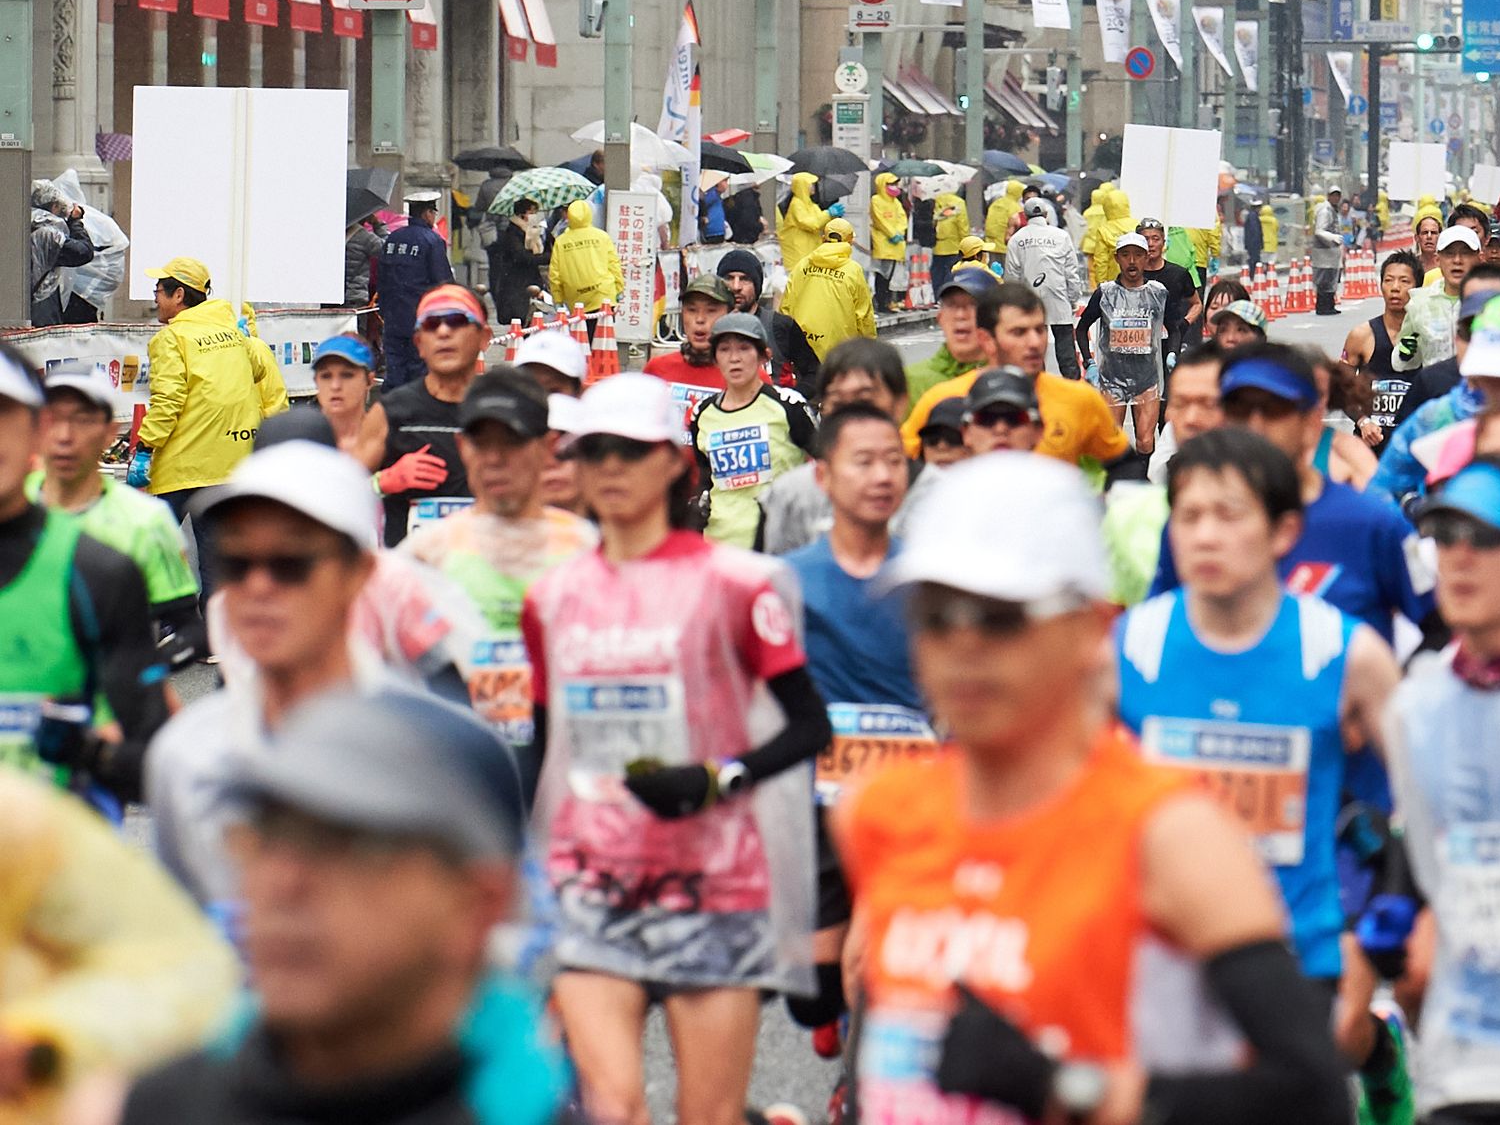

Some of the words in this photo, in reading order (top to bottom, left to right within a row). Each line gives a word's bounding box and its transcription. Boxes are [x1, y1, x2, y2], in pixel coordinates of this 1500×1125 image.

[386, 242, 419, 257] 警視庁
[1017, 238, 1057, 248] OFFICIAL
[723, 427, 761, 442] 東京メトロ
[711, 447, 758, 474] A5361
